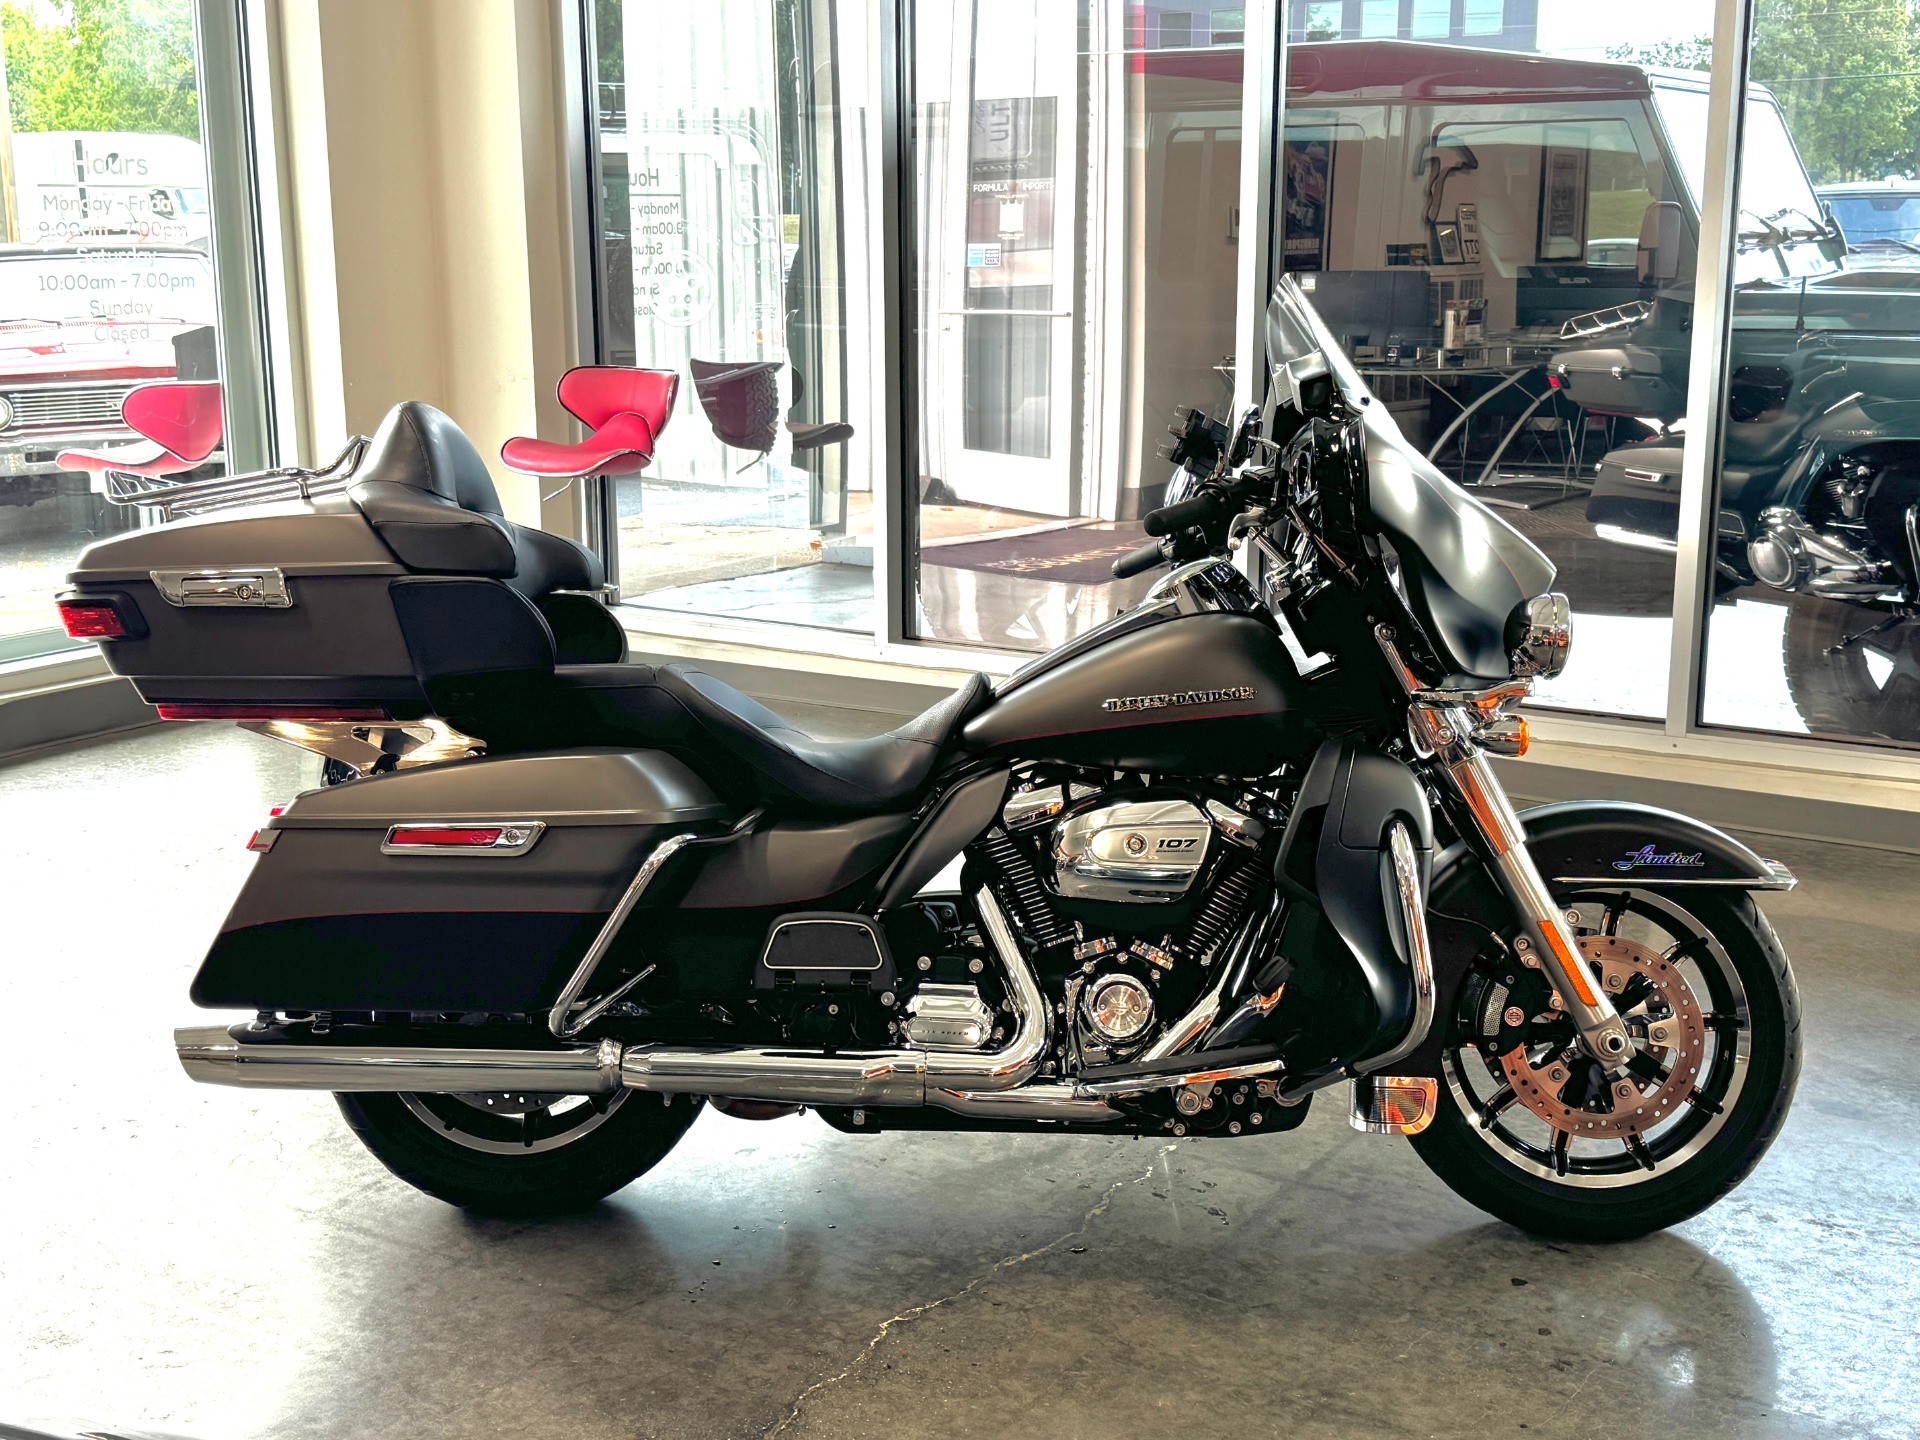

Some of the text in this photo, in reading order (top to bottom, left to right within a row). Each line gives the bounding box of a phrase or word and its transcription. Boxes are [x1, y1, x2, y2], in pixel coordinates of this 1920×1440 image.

[73, 150, 148, 175] Hours
[973, 180, 1055, 193] FORMULA IMPORTS
[43, 195, 112, 215] Monday
[39, 274, 116, 291] 10:00am
[131, 273, 195, 292] 7:00pm
[90, 300, 153, 318] Sunday
[95, 325, 150, 342] Closed
[1158, 838, 1199, 849] 107
[1612, 845, 1705, 871] Limited
